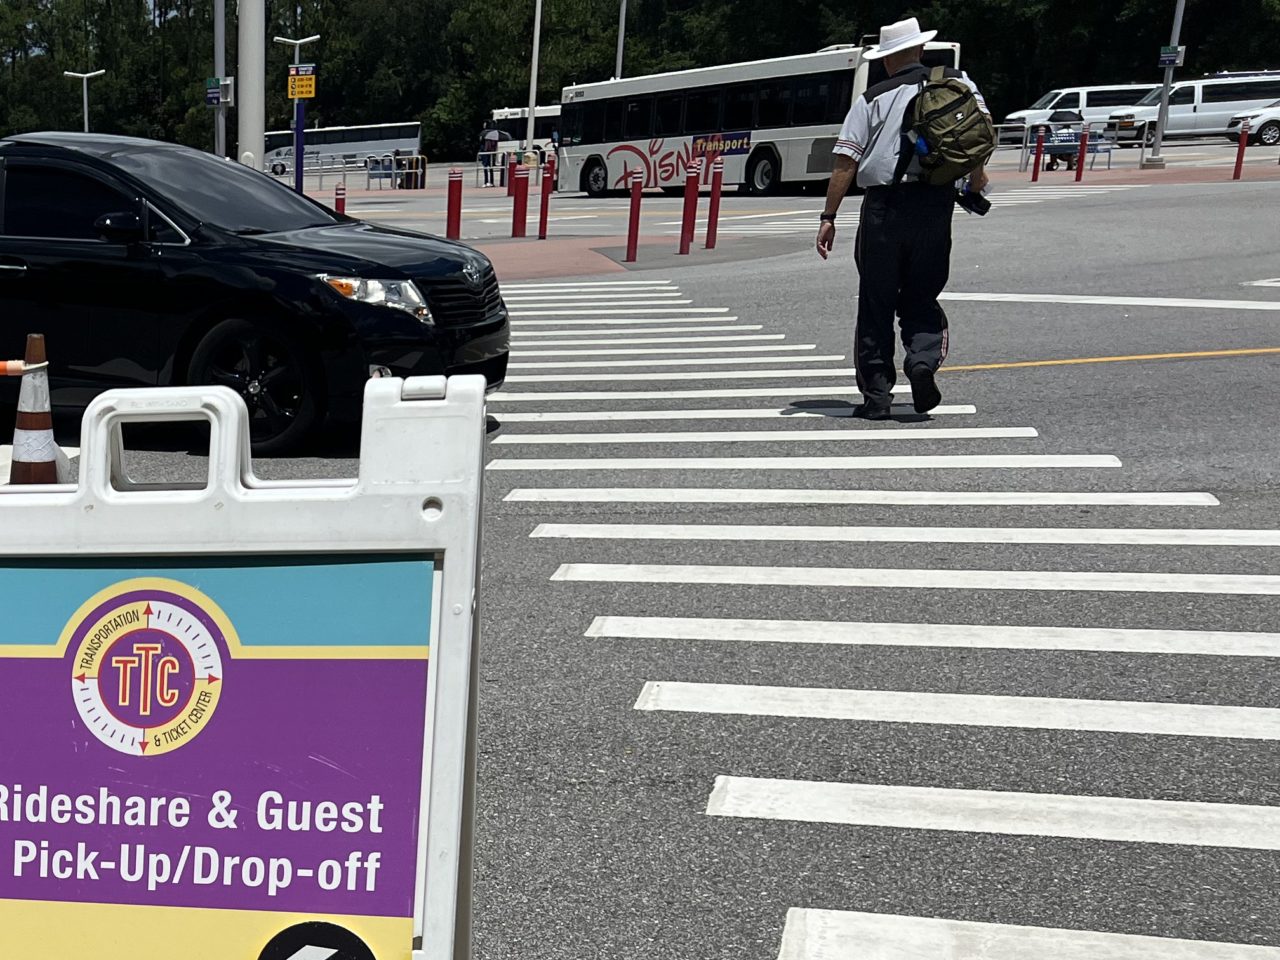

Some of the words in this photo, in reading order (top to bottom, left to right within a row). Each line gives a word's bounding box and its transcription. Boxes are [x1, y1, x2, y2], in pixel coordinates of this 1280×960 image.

[80, 609, 140, 670] TRANSPORTATION
[112, 643, 180, 716] TTC
[154, 734, 161, 747] &
[162, 719, 191, 744] TICKET
[188, 690, 212, 724] CENTER
[207, 790, 238, 829] &
[256, 790, 384, 833] Guest
[13, 839, 381, 896] Pick-Up/Drop-off
